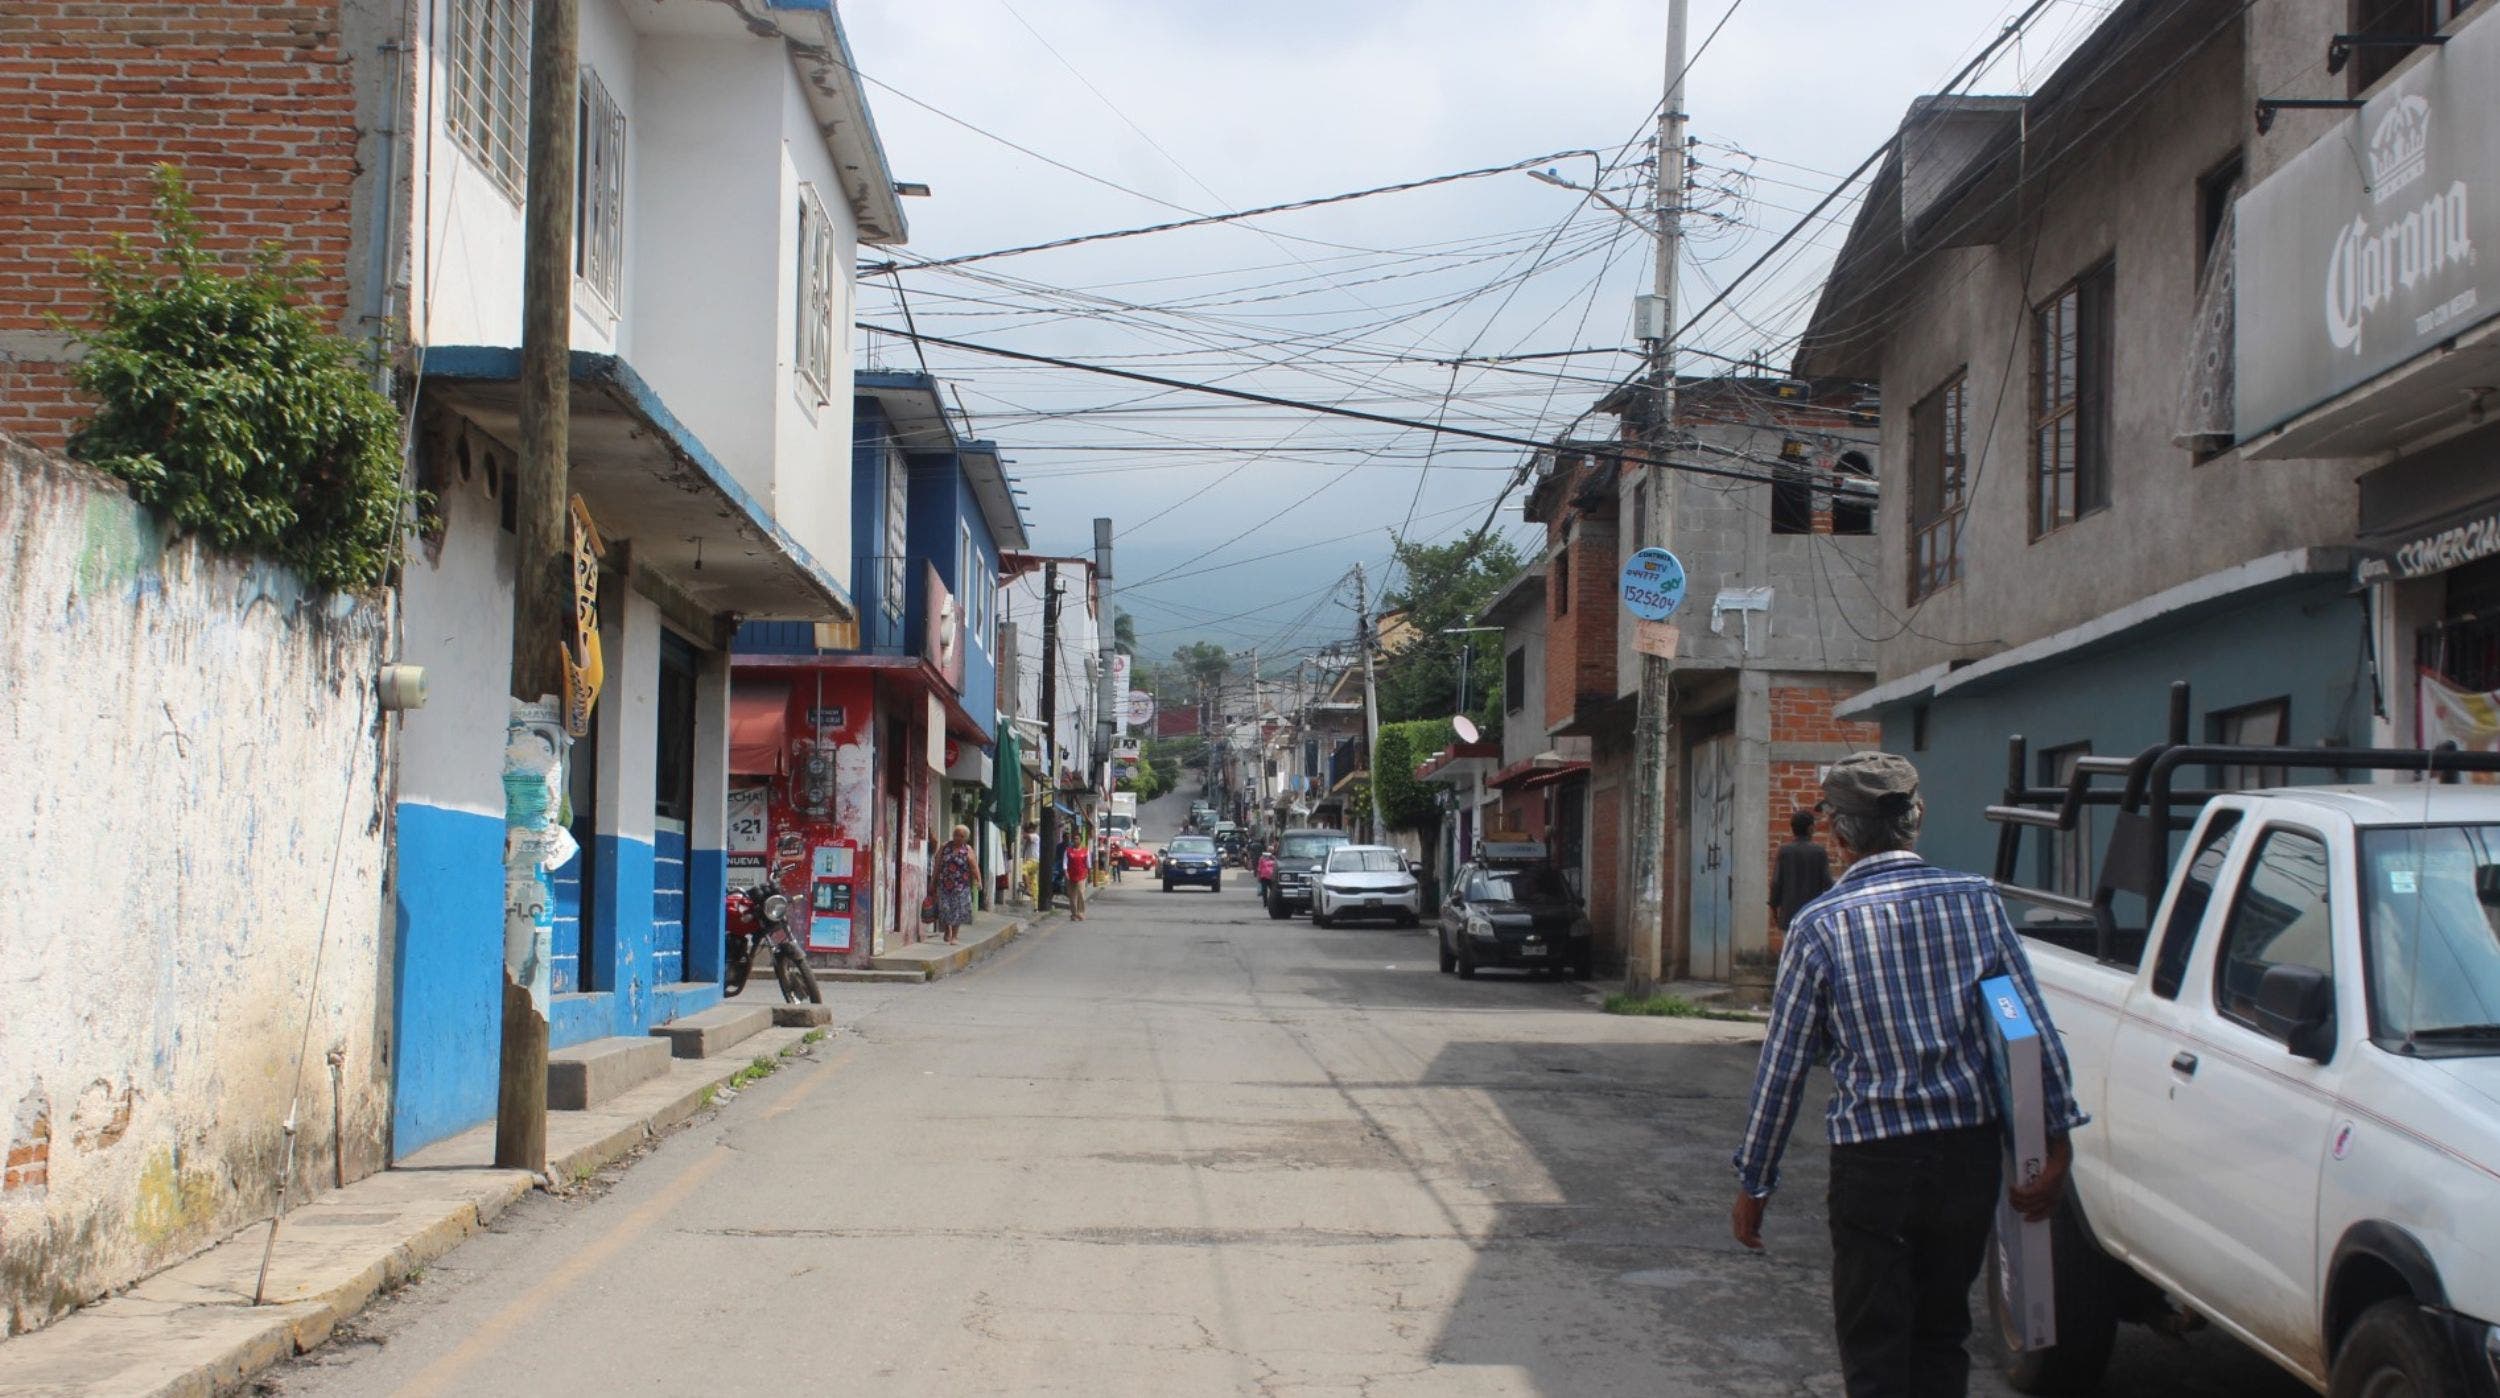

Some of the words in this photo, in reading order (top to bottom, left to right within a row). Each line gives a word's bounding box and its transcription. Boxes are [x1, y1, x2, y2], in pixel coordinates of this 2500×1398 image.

[2326, 179, 2471, 356] Corona
[1624, 585, 1676, 611] 1525204
[732, 819, 761, 835] $21
